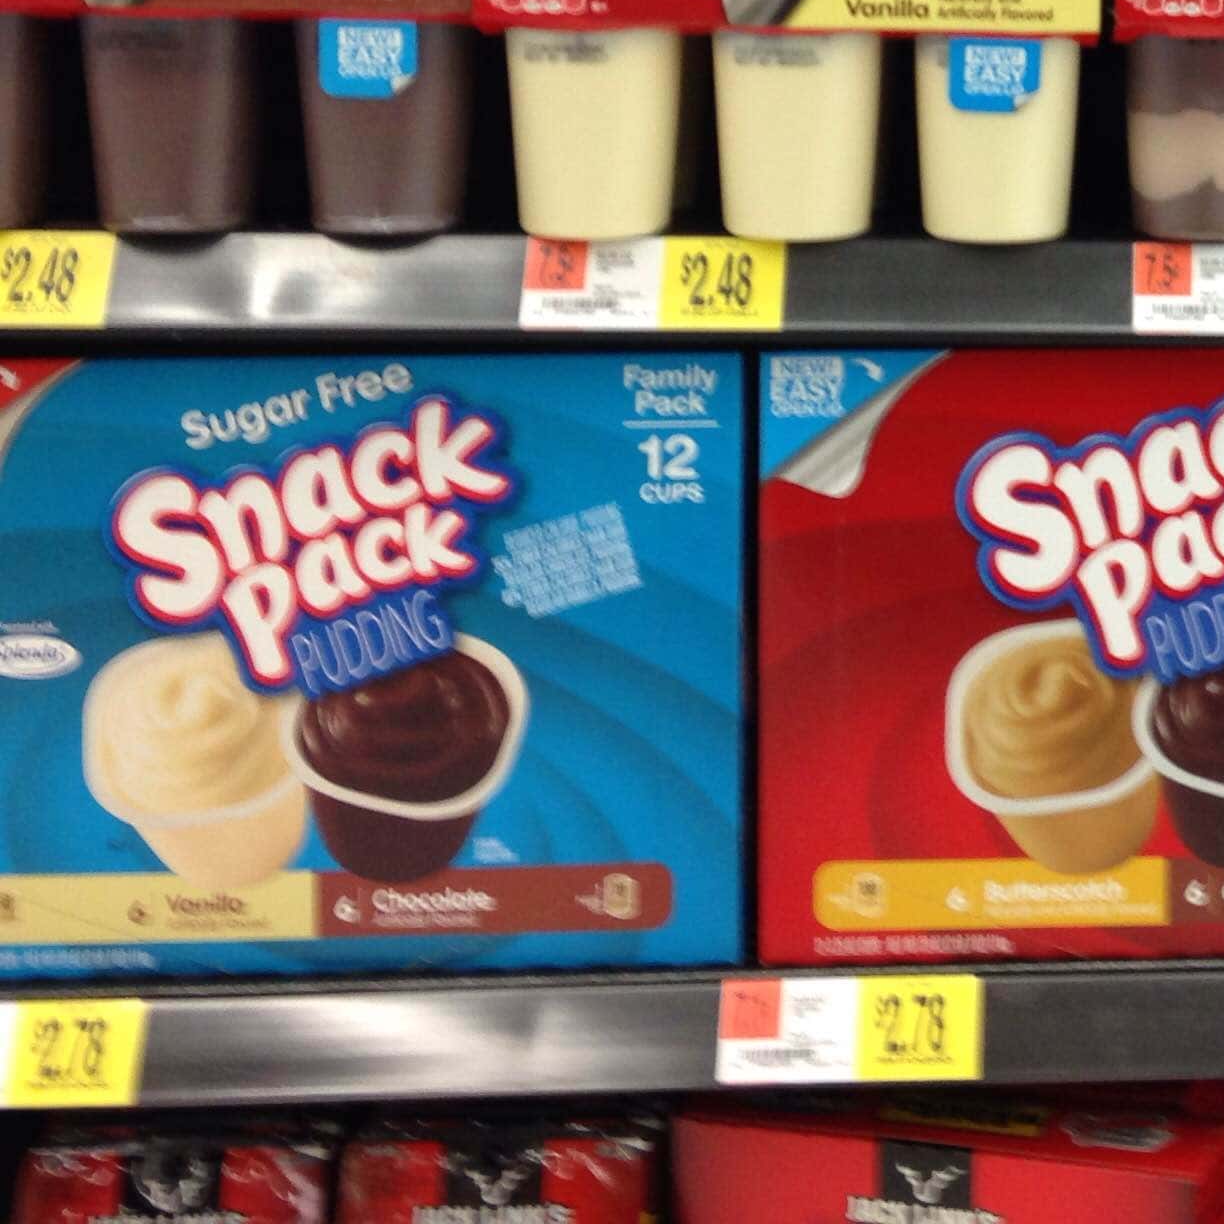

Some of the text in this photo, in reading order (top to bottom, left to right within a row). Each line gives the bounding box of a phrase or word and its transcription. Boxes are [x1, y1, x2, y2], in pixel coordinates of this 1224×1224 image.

[1, 246, 78, 303] $2.48
[682, 251, 753, 306] $2.48
[623, 366, 717, 395] Family
[634, 391, 705, 417] Pack
[180, 363, 413, 450] Sugar Free
[639, 436, 699, 480] 12
[117, 400, 509, 620] Snack
[639, 481, 705, 505] CUPS
[291, 591, 452, 695] PUDDING
[372, 889, 497, 913] Chocolate
